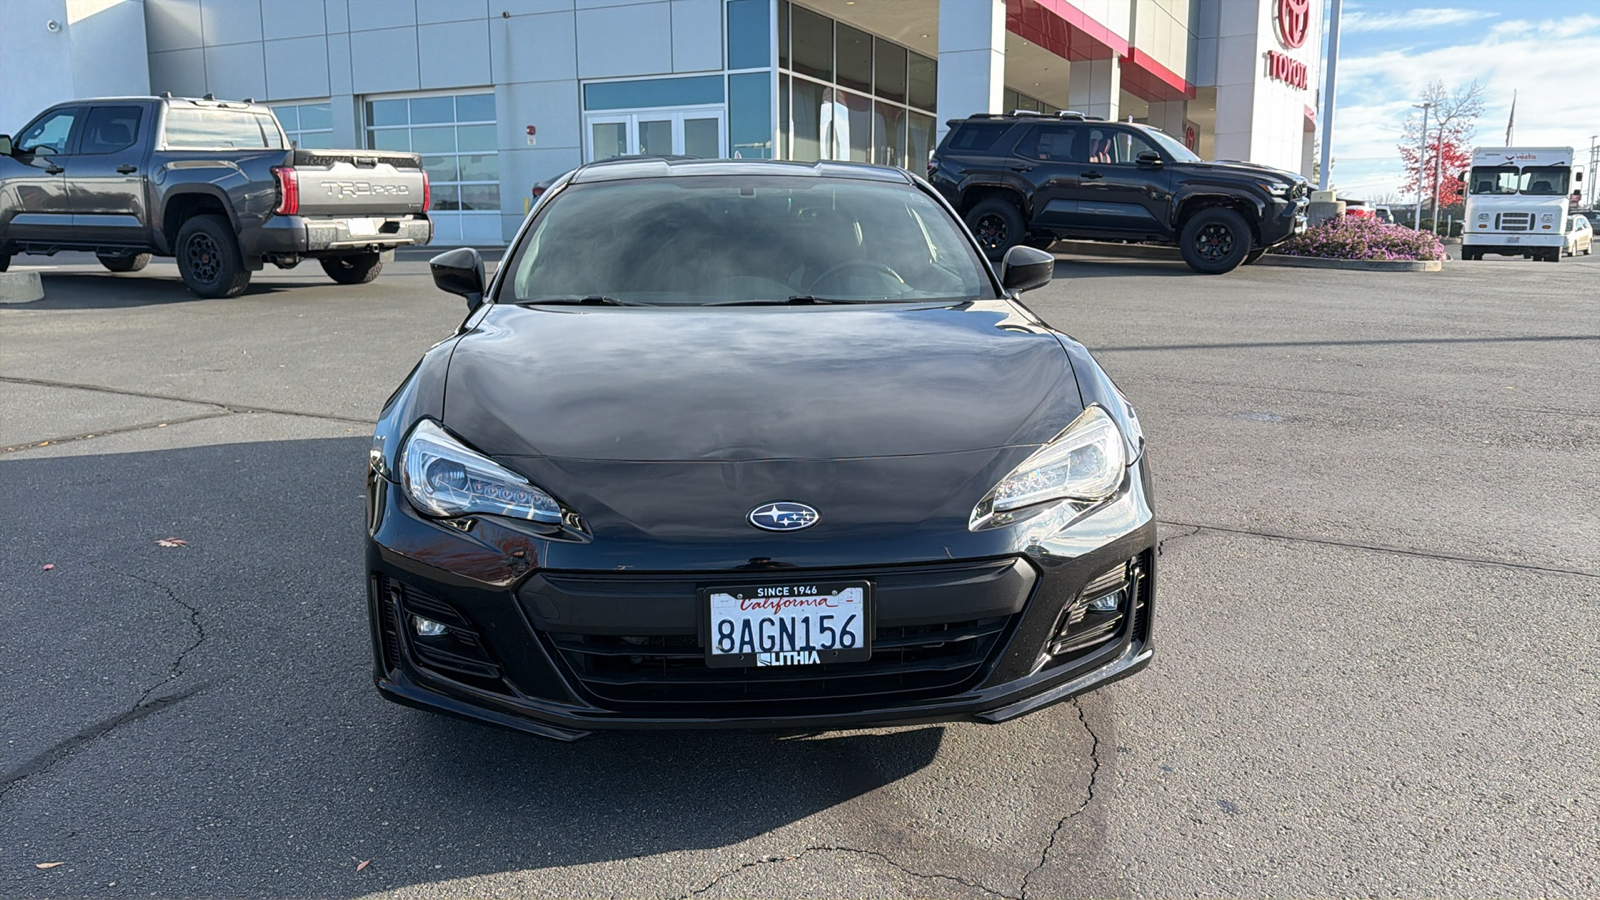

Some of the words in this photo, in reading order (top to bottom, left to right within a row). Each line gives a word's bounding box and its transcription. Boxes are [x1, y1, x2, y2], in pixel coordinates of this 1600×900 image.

[757, 586, 790, 597] SINCE
[793, 585, 818, 595] 1946
[740, 597, 839, 615] California
[717, 614, 857, 653] 8AGN156
[771, 651, 821, 666] LITHIA
